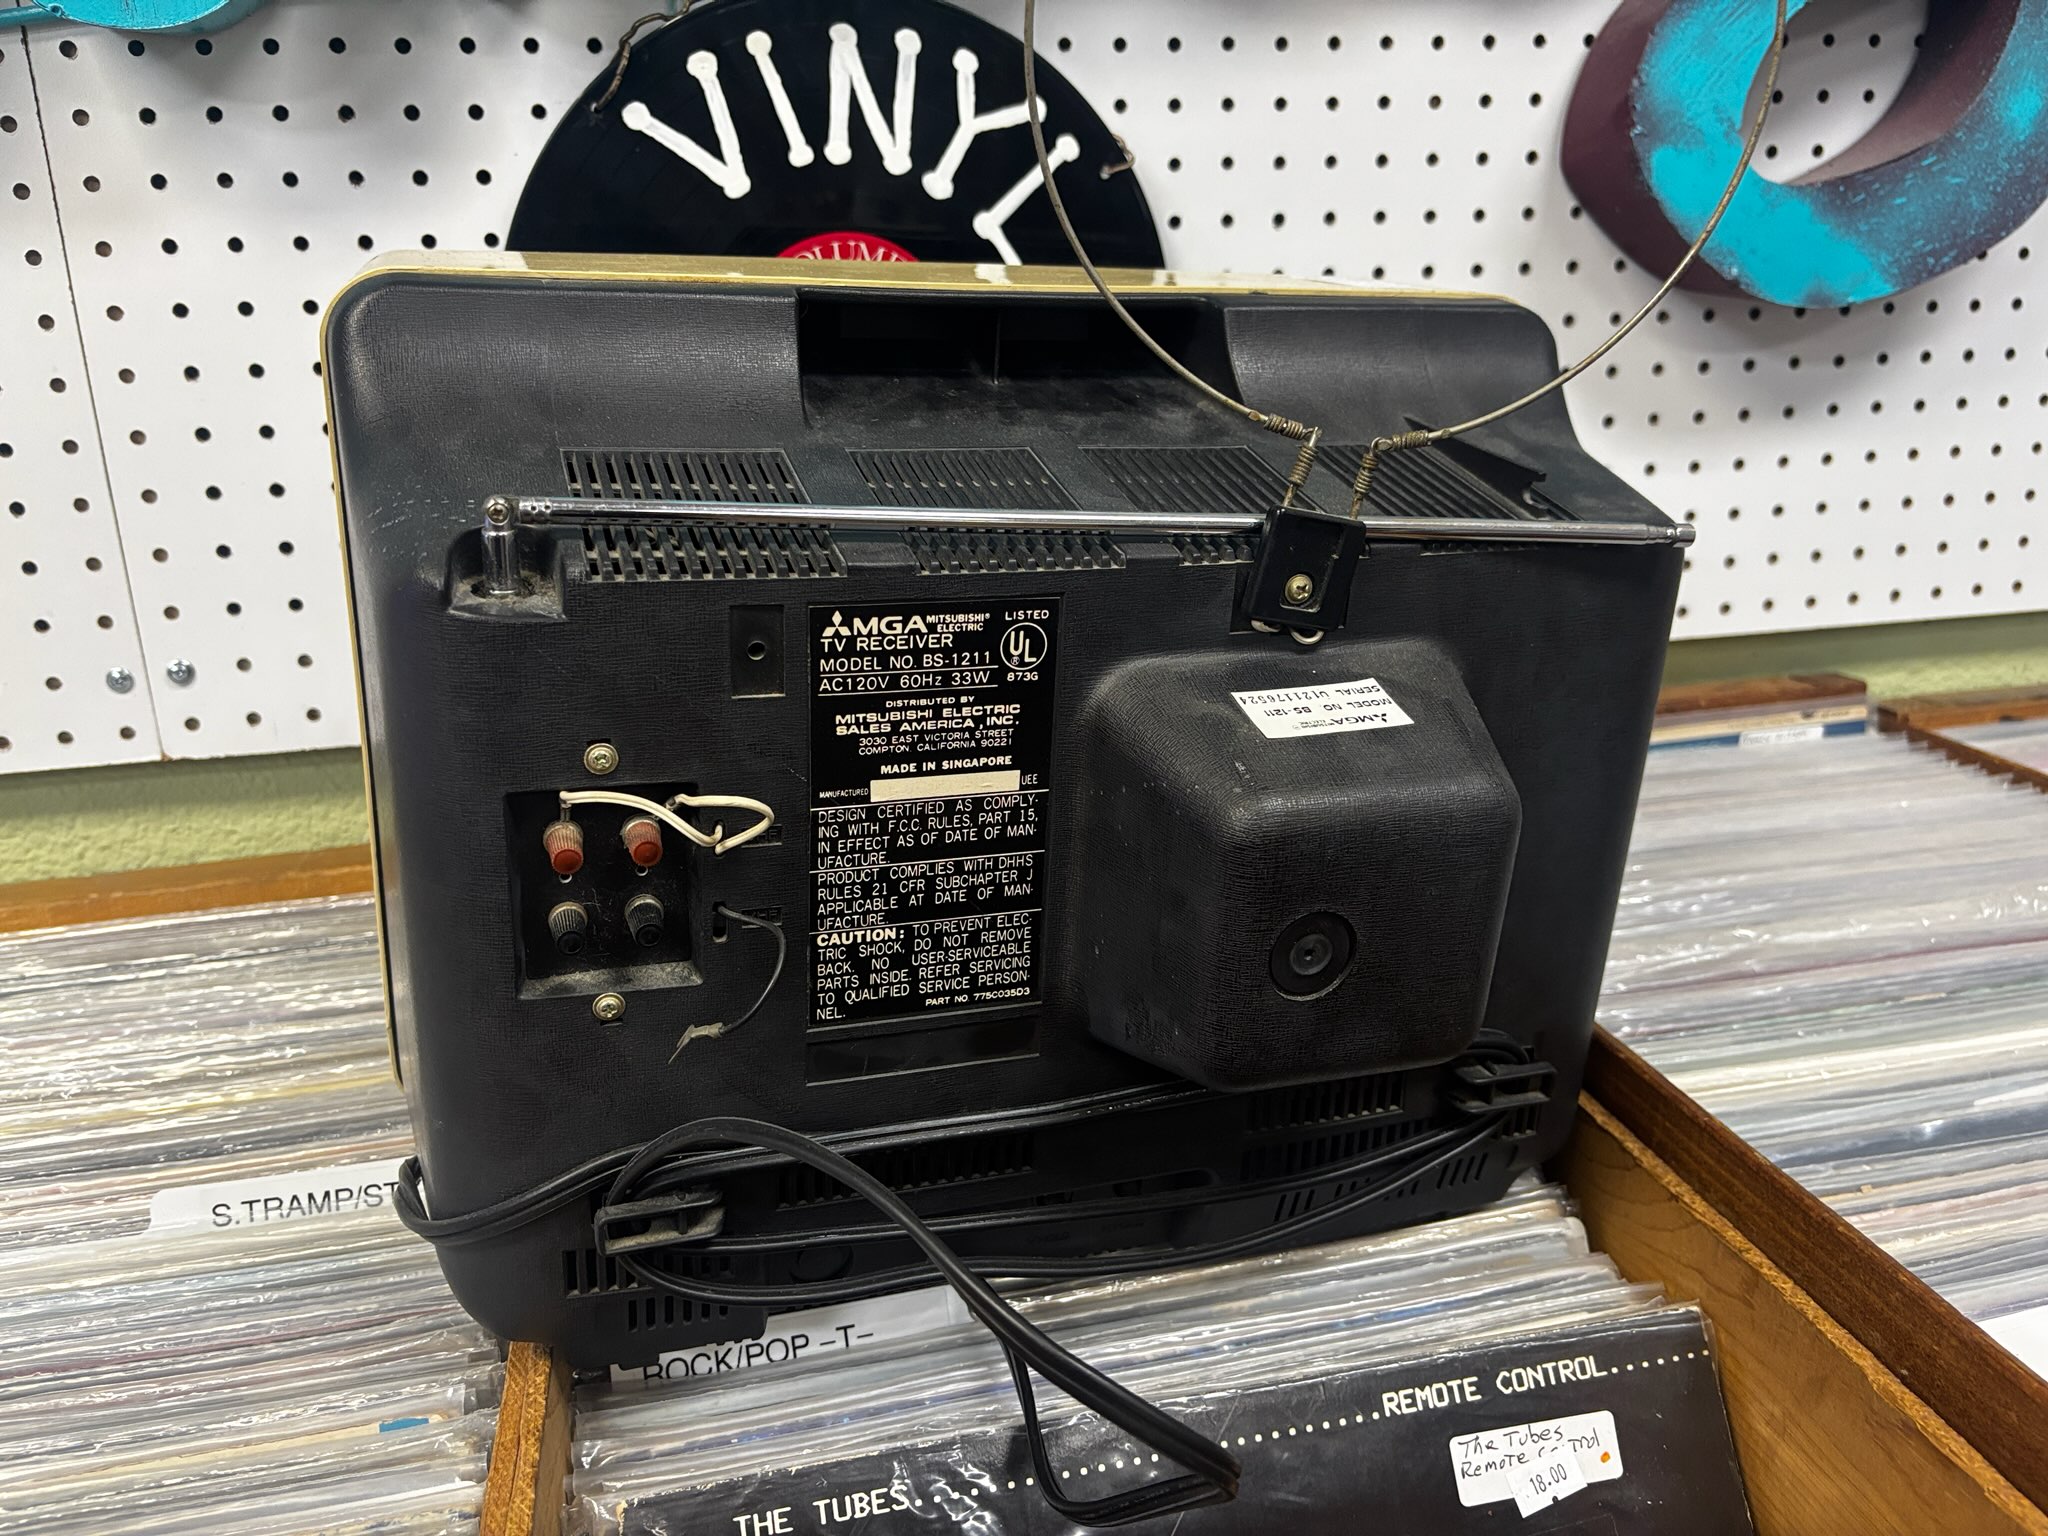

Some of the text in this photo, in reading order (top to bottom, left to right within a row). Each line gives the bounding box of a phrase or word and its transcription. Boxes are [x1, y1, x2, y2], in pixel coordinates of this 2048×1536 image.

[620, 22, 1081, 267] VINYL
[853, 615, 928, 636] MGA
[1005, 610, 1049, 621] LISTED
[937, 623, 984, 633] ELECTRIC
[820, 634, 953, 652] TV RECEIVER
[1009, 630, 1038, 663] UL
[819, 651, 990, 672] MODEL NO. BS-1211
[819, 671, 991, 692] AC120V 60Hz 33W
[1007, 672, 1039, 682] 873G
[1336, 685, 1380, 696] SERIAL
[885, 696, 975, 708] DISTRIBUTED BY
[1264, 706, 1312, 717] BS-1211
[1347, 698, 1392, 708] MODEL
[835, 704, 1021, 725] MITSUBISHI ELECTRIC
[1332, 715, 1377, 725] MGA
[835, 723, 891, 736] SALES
[859, 728, 1014, 747] 3030 EAST VICTORIA STREET
[917, 739, 976, 752] CALIFORNIA
[981, 738, 1012, 747] 90221
[880, 756, 1012, 775] MADE IN SINGAPORE
[819, 787, 869, 799] MANUFACTURED
[818, 794, 1038, 824] DESIGN CERTIFIED AS COMPLY-
[819, 825, 839, 839] ING
[848, 822, 880, 835] WITH
[978, 811, 1011, 825] PART
[1020, 810, 1038, 822] 15,
[818, 823, 1037, 854] IN EFFECT AS OF DATE OF MAN-
[818, 851, 890, 869] UFACTURE.
[818, 854, 1033, 885] PRODUCT COMPLIES WITH DHHS
[818, 869, 1033, 900] RULES 21 CFR SUBCHAPTER J
[817, 883, 1034, 915] APPLICABLE AT DATE OF MAN-
[816, 913, 1032, 946] CAUTION: TO PREVENT ELEC-
[817, 913, 889, 931] UFACTURE.
[818, 927, 1032, 961] TRIC SHOCK, DO NOT REMOVE
[817, 963, 854, 977] BACK.
[871, 958, 890, 970] NO
[817, 955, 1031, 991] PARTS INSIDE. REFER SERVICING
[817, 970, 1030, 1006] TO QUALIFIED SERVICE PERSON-
[925, 998, 949, 1007] PART
[816, 1008, 846, 1020] NEL.
[1383, 1355, 1607, 1417] REMOTE CONTROL
[1458, 1425, 1563, 1458] The Tubes
[1530, 1463, 1567, 1495] 18.00
[733, 1484, 909, 1536] THE TUBES
